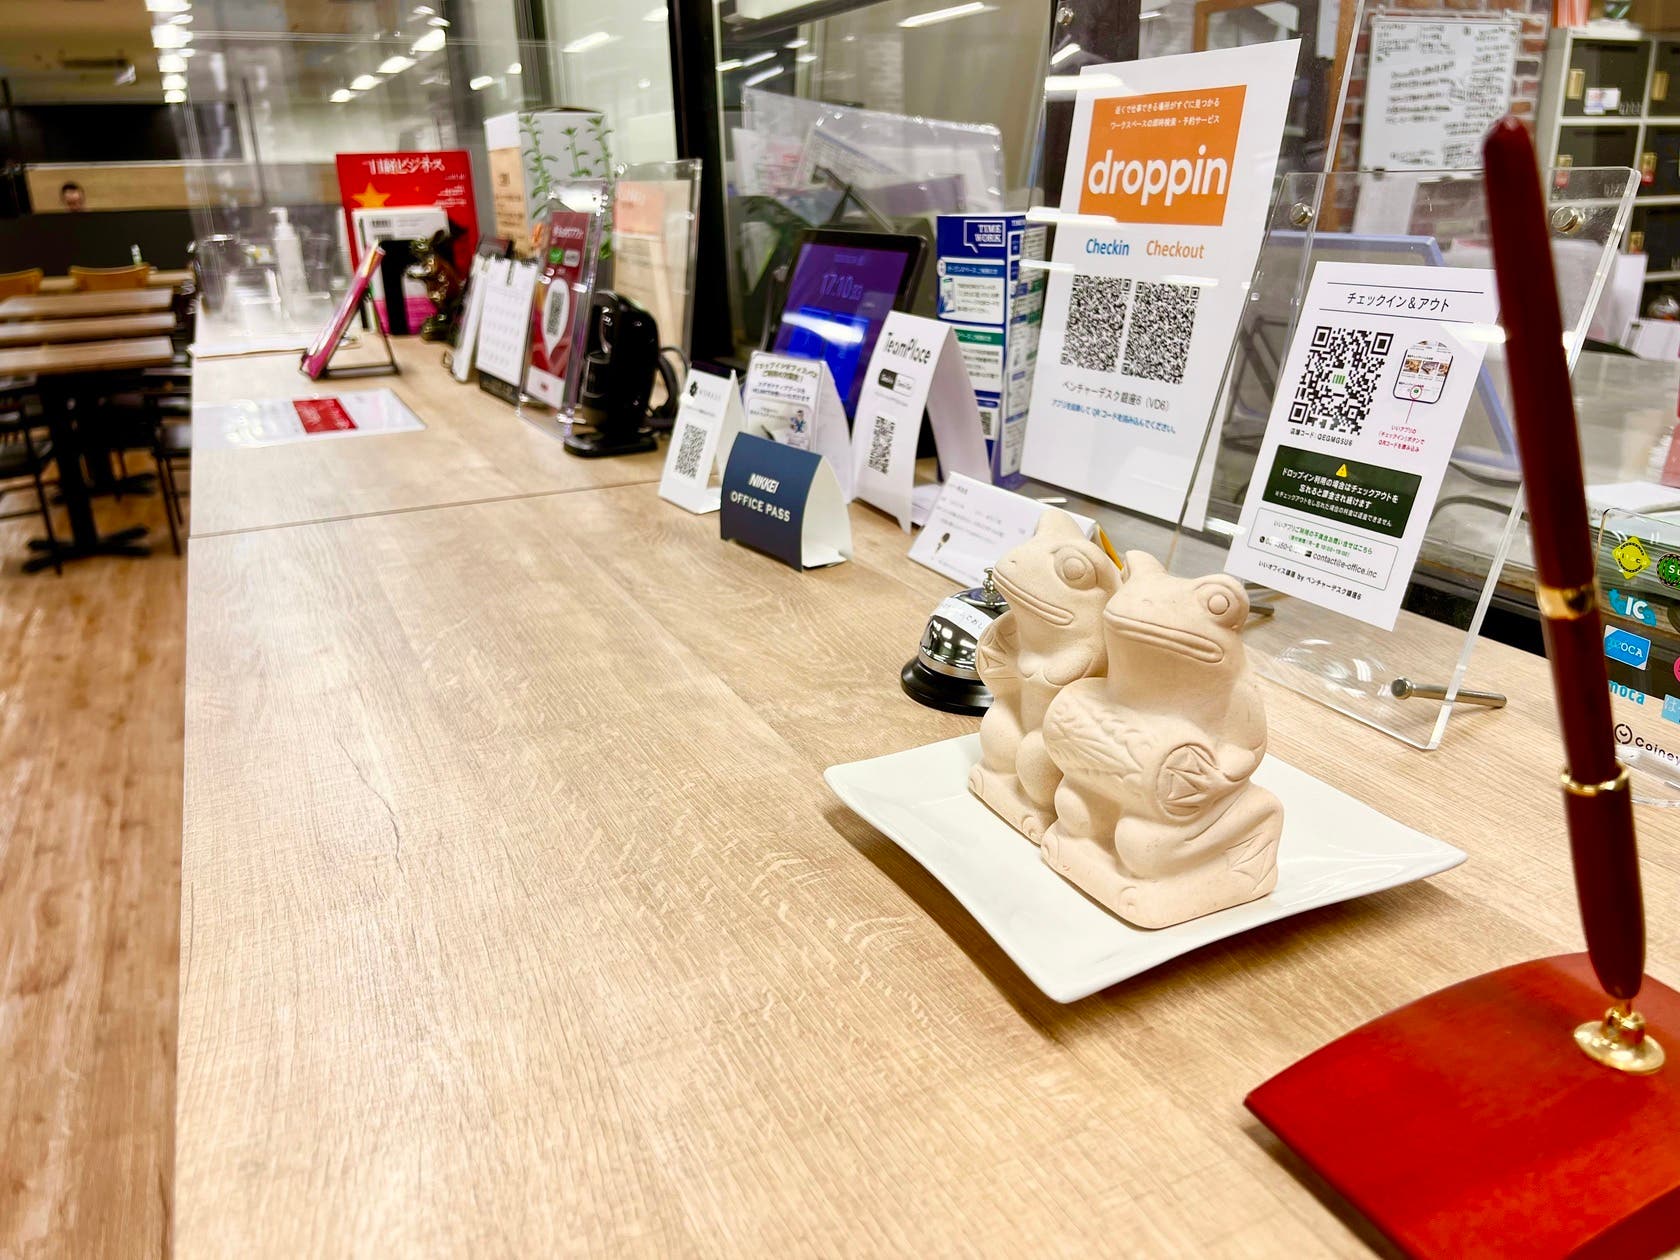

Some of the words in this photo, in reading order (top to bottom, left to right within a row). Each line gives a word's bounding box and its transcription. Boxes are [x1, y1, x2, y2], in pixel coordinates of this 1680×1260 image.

[1088, 144, 1228, 206] droppin
[974, 233, 1002, 243] WORK
[977, 224, 1002, 234] TIME
[1086, 238, 1130, 256] Checkin
[1146, 240, 1205, 259] Checkout
[1347, 292, 1450, 313] チェックイン＆アウト
[884, 332, 931, 364] TeamPlace
[749, 473, 780, 494] NIKKEI
[1282, 467, 1399, 504] ドロップイン利用の場合はチェックアウトを
[730, 491, 764, 514] OFFICE
[765, 502, 791, 522] PASS
[1297, 573, 1304, 583] by
[1625, 596, 1648, 620] IC
